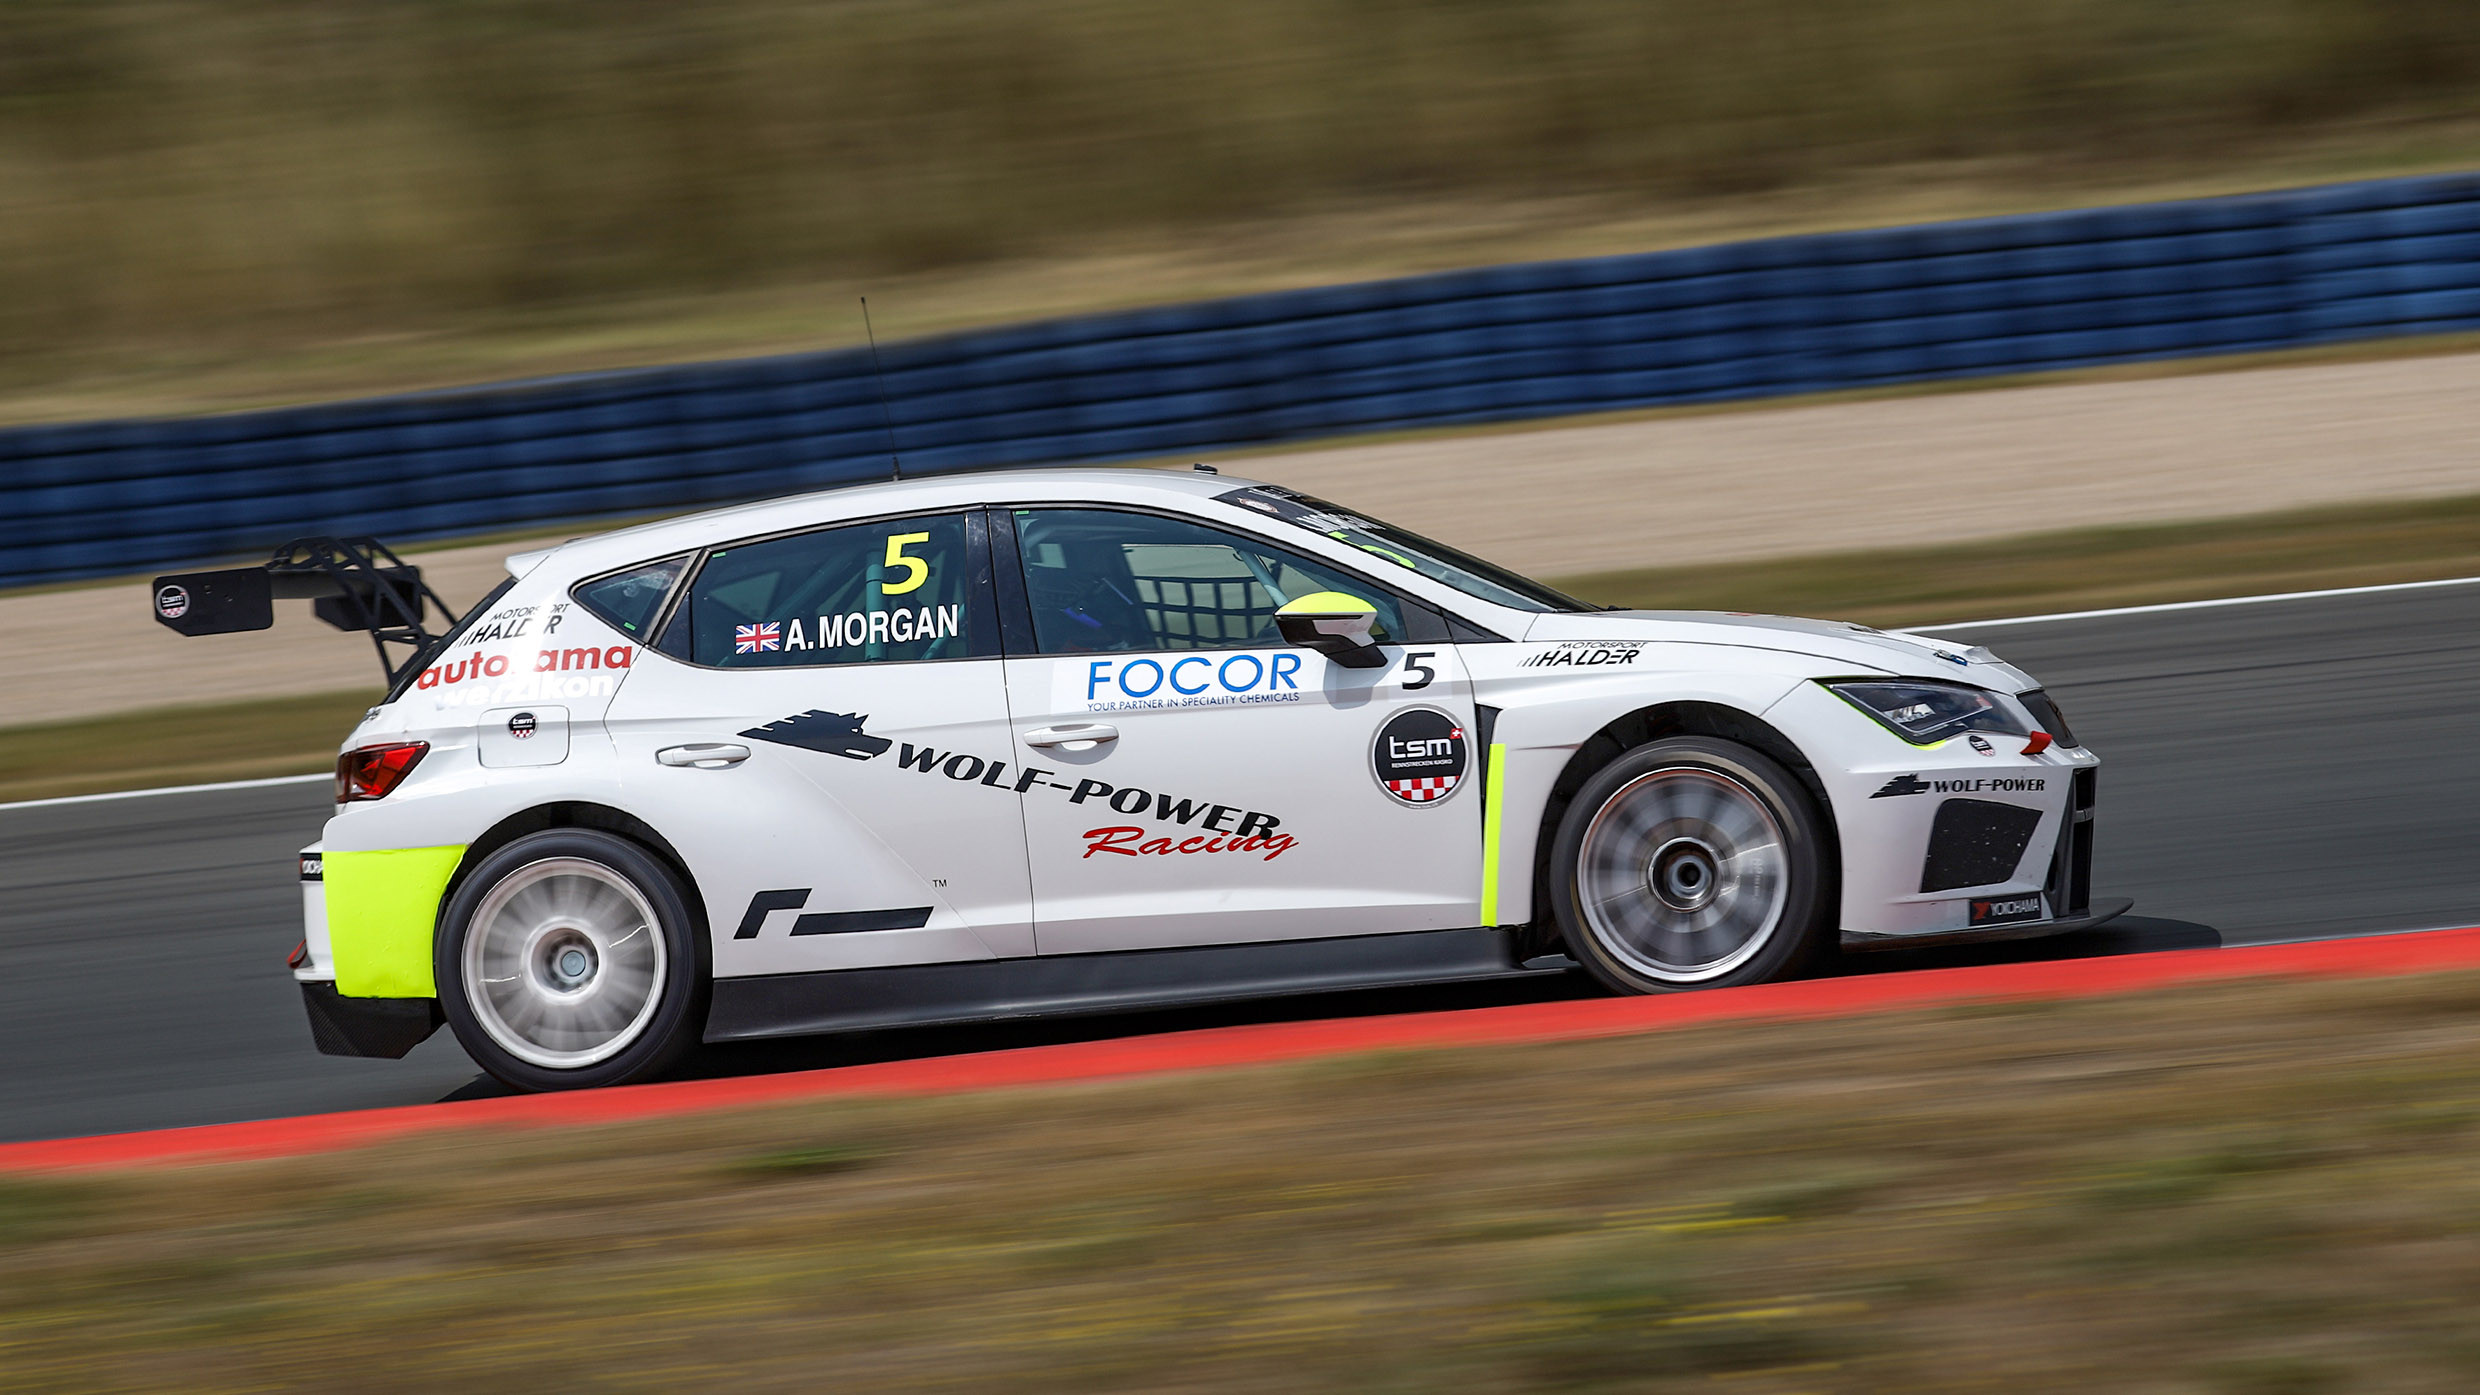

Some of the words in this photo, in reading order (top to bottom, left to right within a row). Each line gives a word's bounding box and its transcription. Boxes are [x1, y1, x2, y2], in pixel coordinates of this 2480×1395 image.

[880, 531, 930, 596] 5
[488, 602, 571, 622] MOTORRT
[818, 603, 959, 650] MORGAN
[469, 614, 563, 645] HALDR
[1535, 649, 1640, 667] HALDER
[1557, 641, 1649, 650] MOTORSPORT
[417, 645, 633, 690] autoama
[1087, 653, 1302, 700] FOCOR
[1401, 651, 1436, 691] 5
[1087, 702, 1116, 712] YOUR
[1119, 699, 1164, 710] PARTNER
[1167, 699, 1179, 708] IN
[1182, 695, 1237, 707] SPECIALITY
[1239, 692, 1301, 704] CHEMICALS
[1388, 735, 1453, 759] tsm
[897, 742, 1283, 841] WOLF-POWER
[1934, 777, 2046, 793] WOLF-POWER
[1082, 825, 1300, 862] Racing
[932, 878, 948, 888] TM
